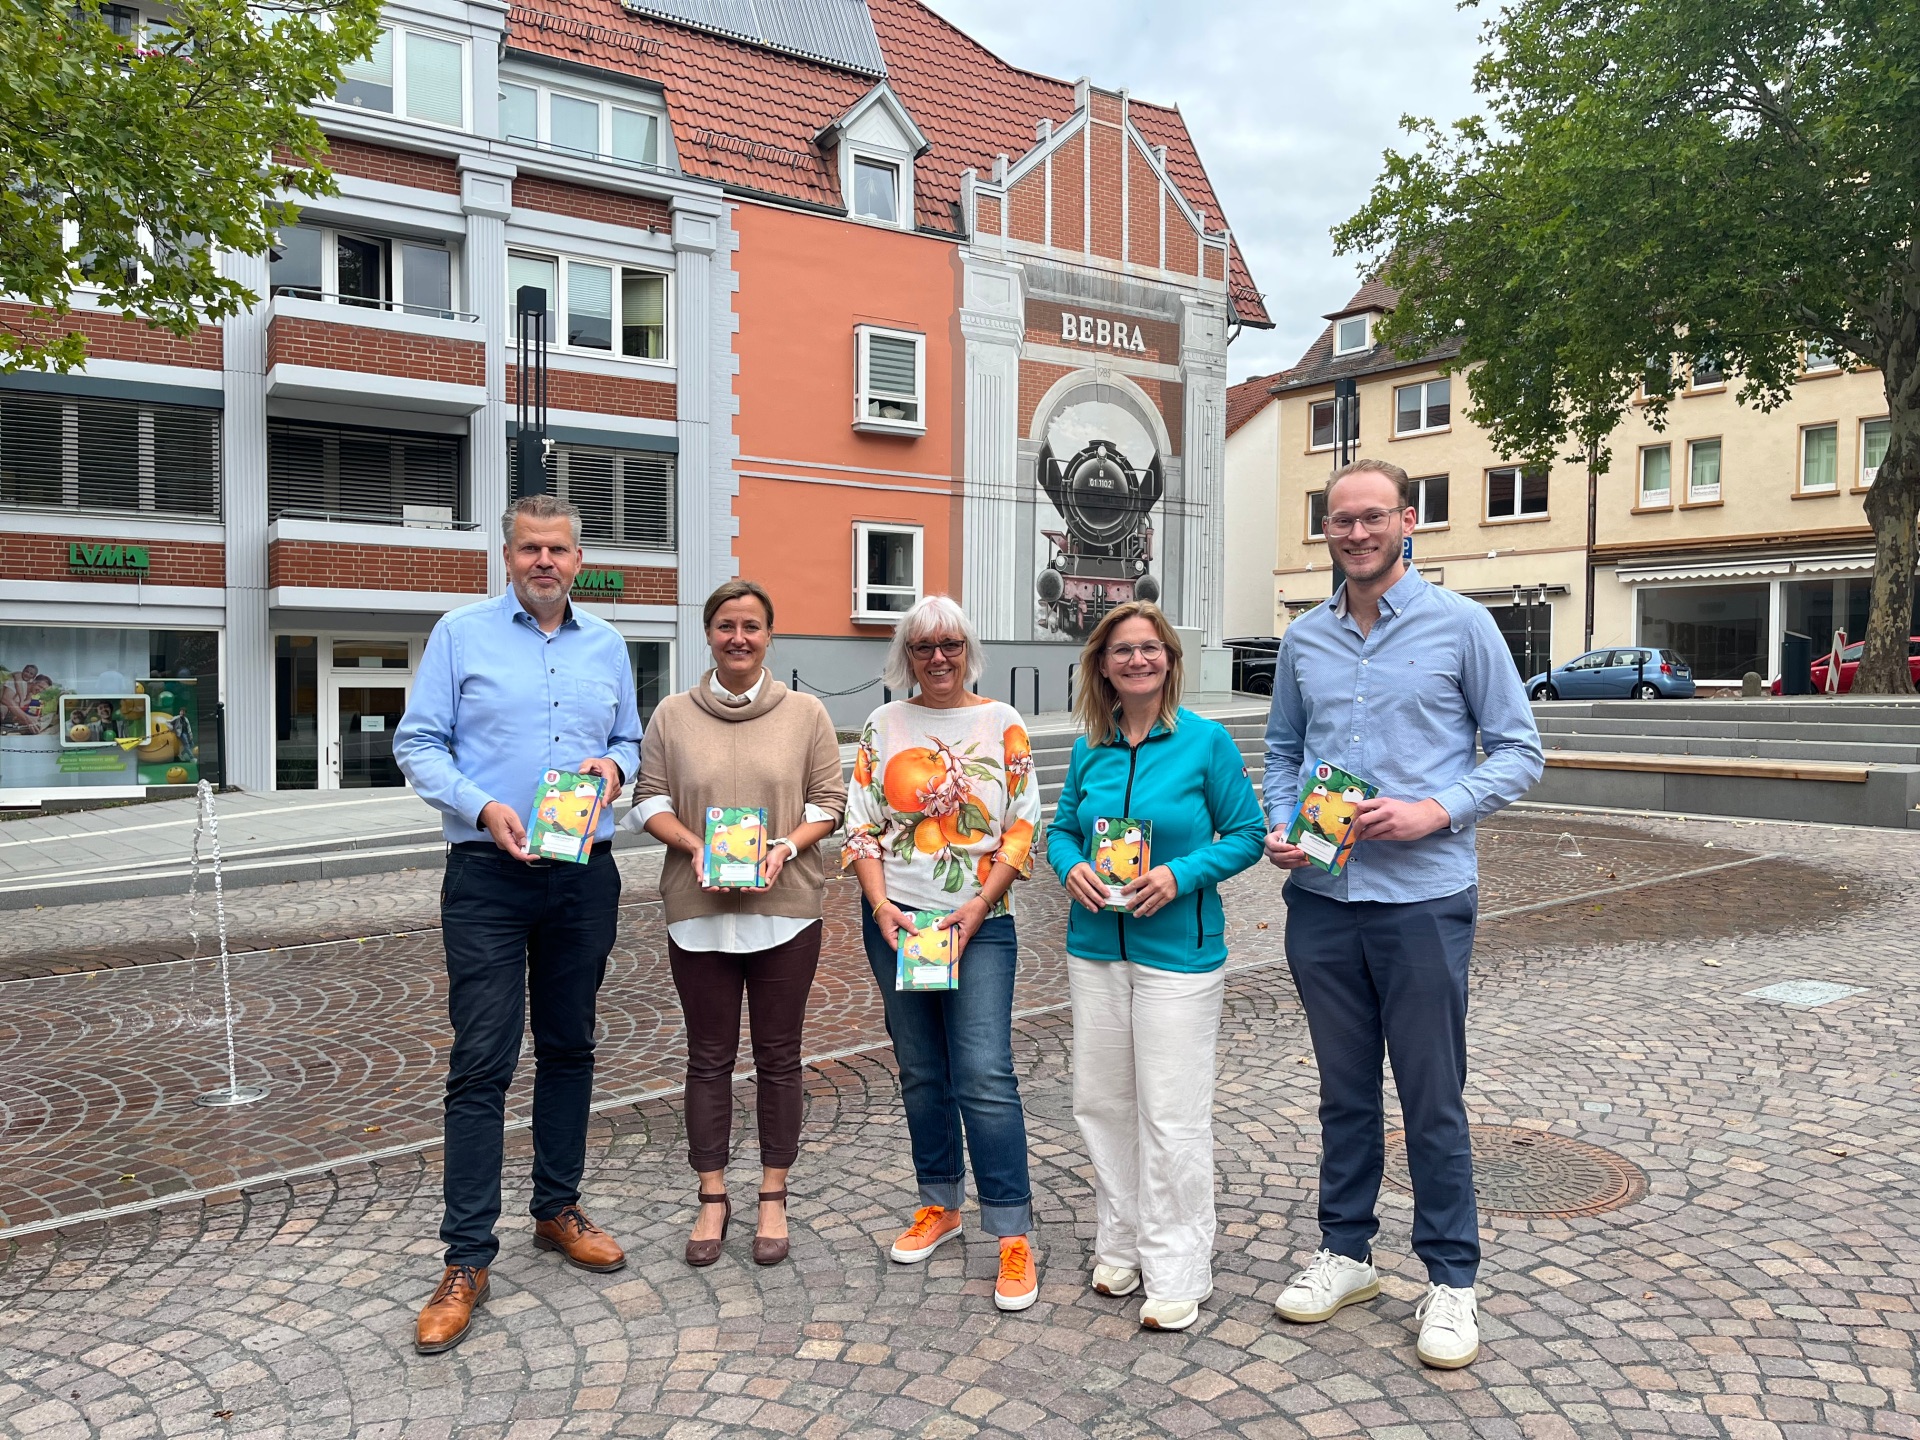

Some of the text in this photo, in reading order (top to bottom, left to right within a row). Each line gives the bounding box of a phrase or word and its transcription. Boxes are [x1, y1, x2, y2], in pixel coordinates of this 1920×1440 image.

[1061, 312, 1147, 352] BEBRA
[69, 543, 123, 566] LVM
[70, 567, 150, 577] VERSICHERUNG
